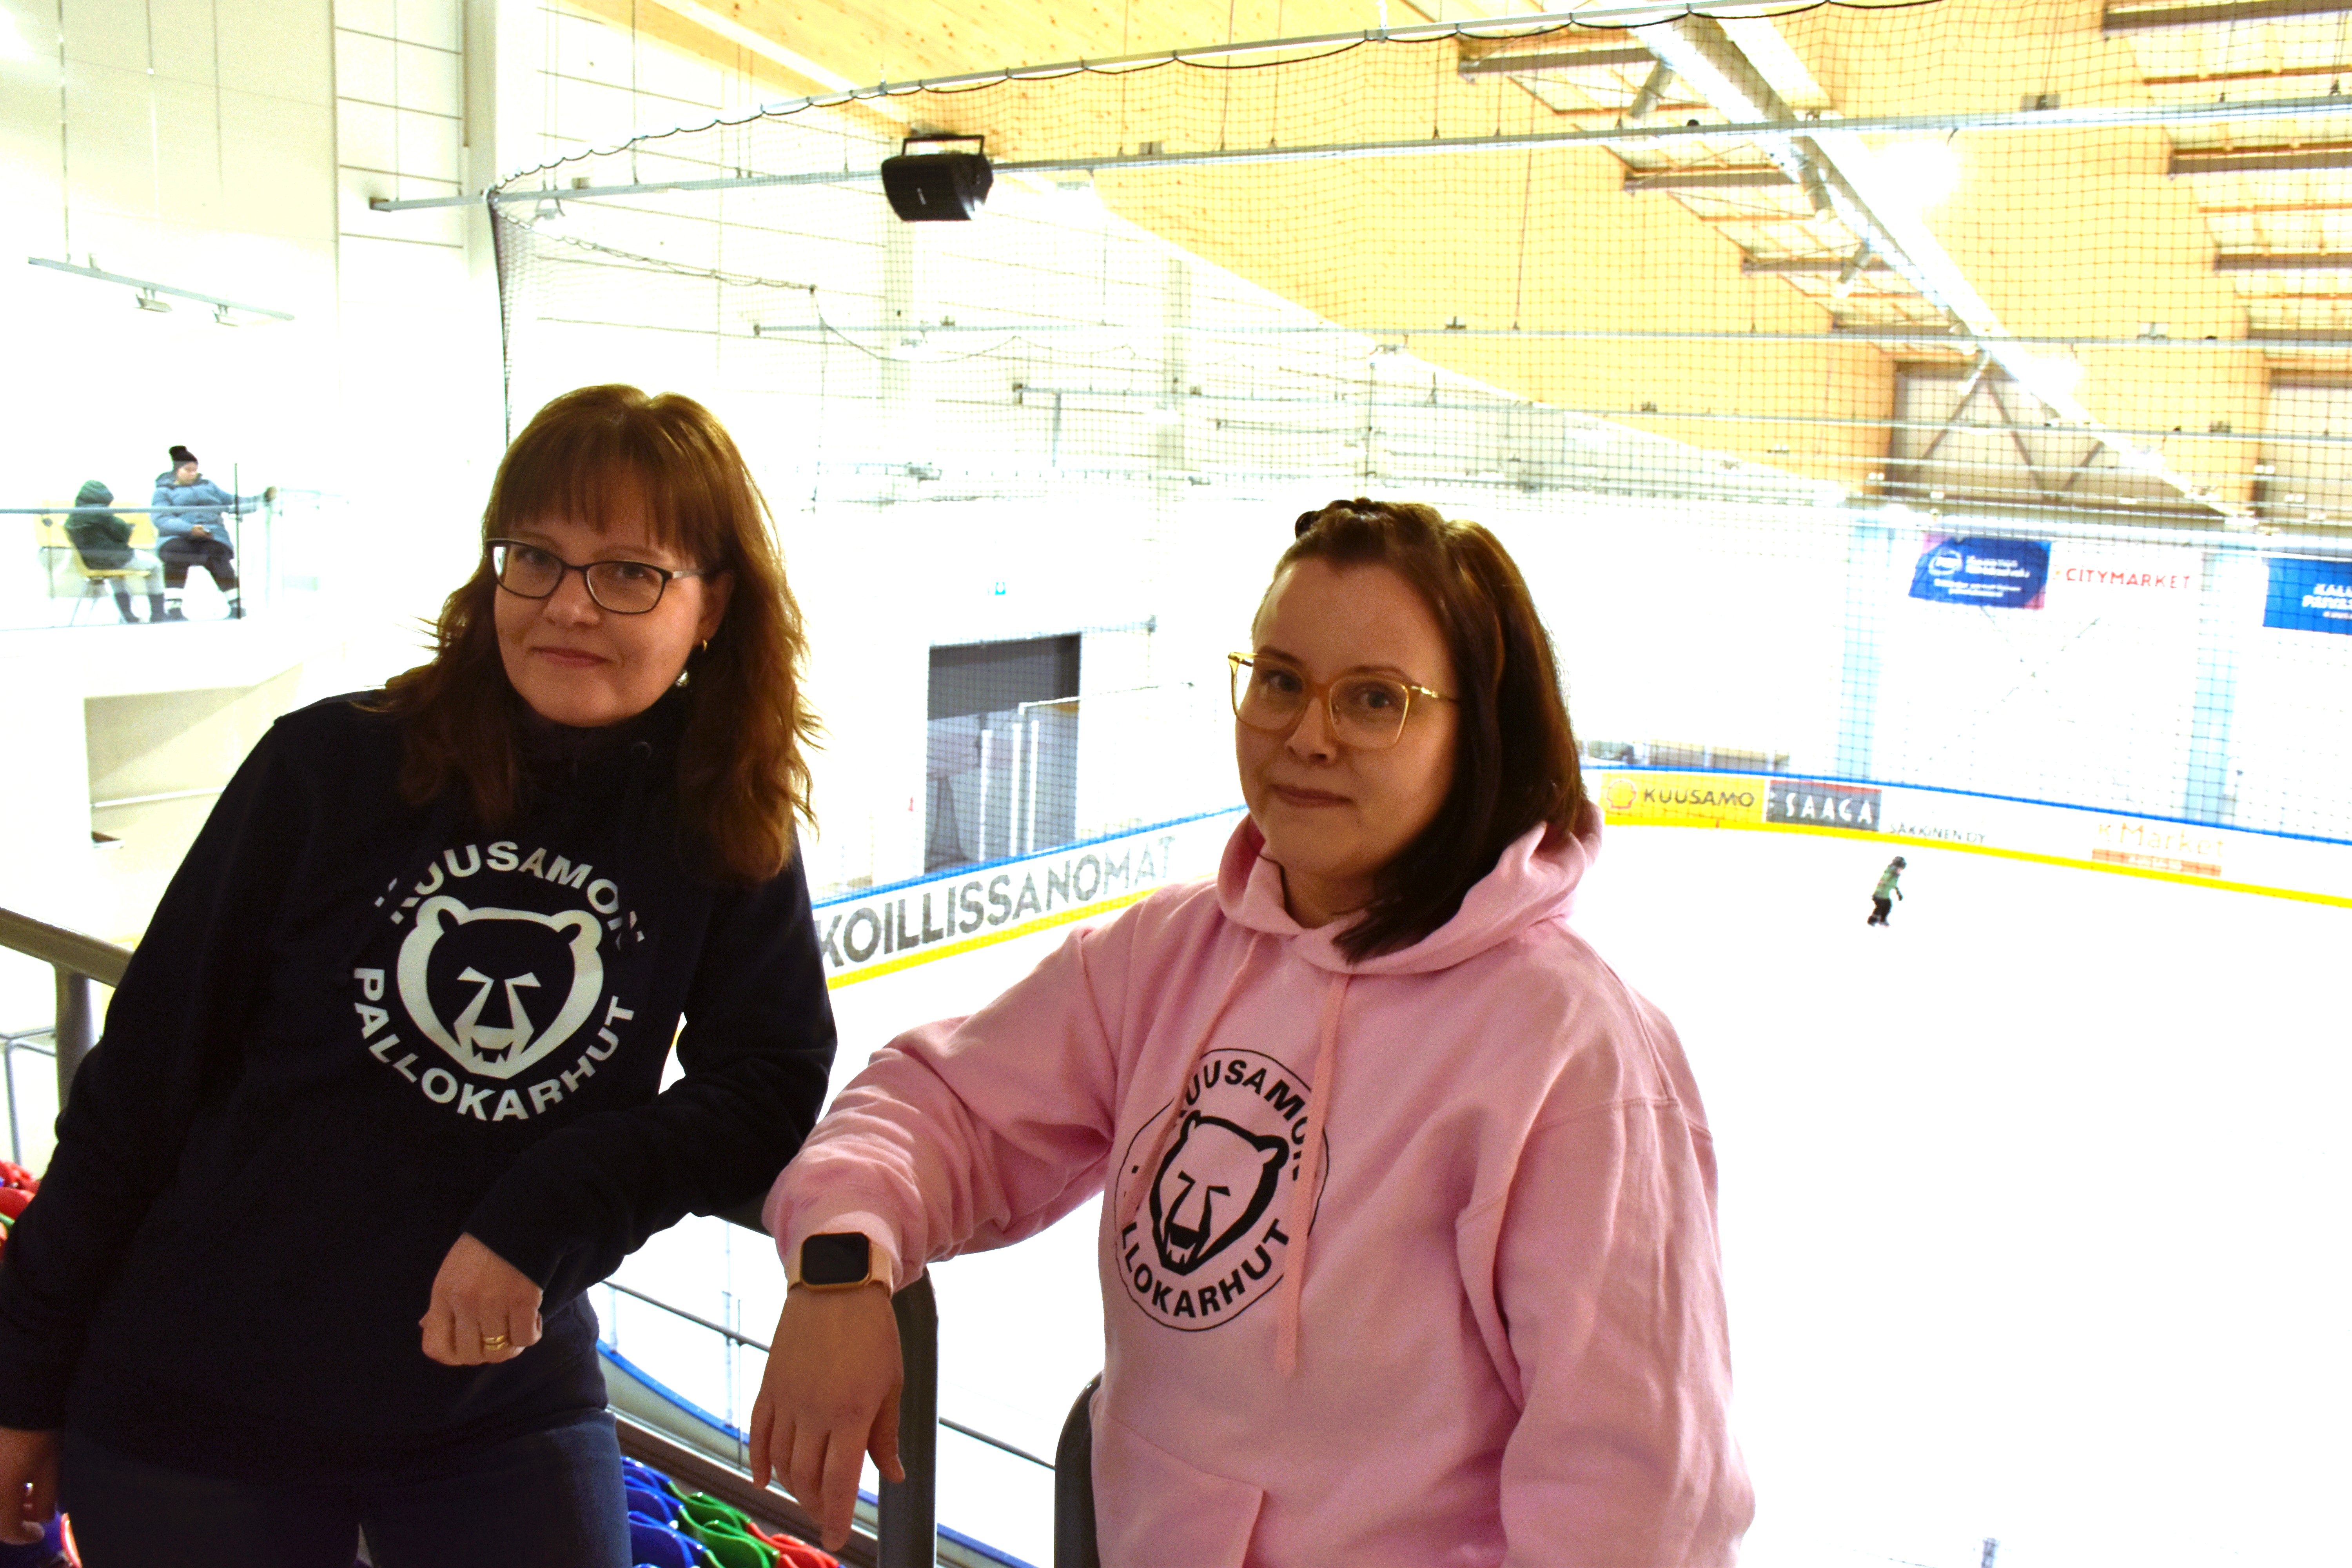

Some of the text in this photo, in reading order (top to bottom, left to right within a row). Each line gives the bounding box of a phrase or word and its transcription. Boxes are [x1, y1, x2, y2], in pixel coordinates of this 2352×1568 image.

[2066, 568, 2190, 589] CITYMARKET
[1644, 788, 1755, 808] KUUSAMO
[1785, 792, 1873, 824] SAAGA
[2120, 822, 2224, 857] Market
[814, 835, 1175, 968] KOILLISSANOMAT
[354, 967, 635, 1122] PALLOKARHUT
[1122, 1166, 1289, 1318] LLOKARHUT
